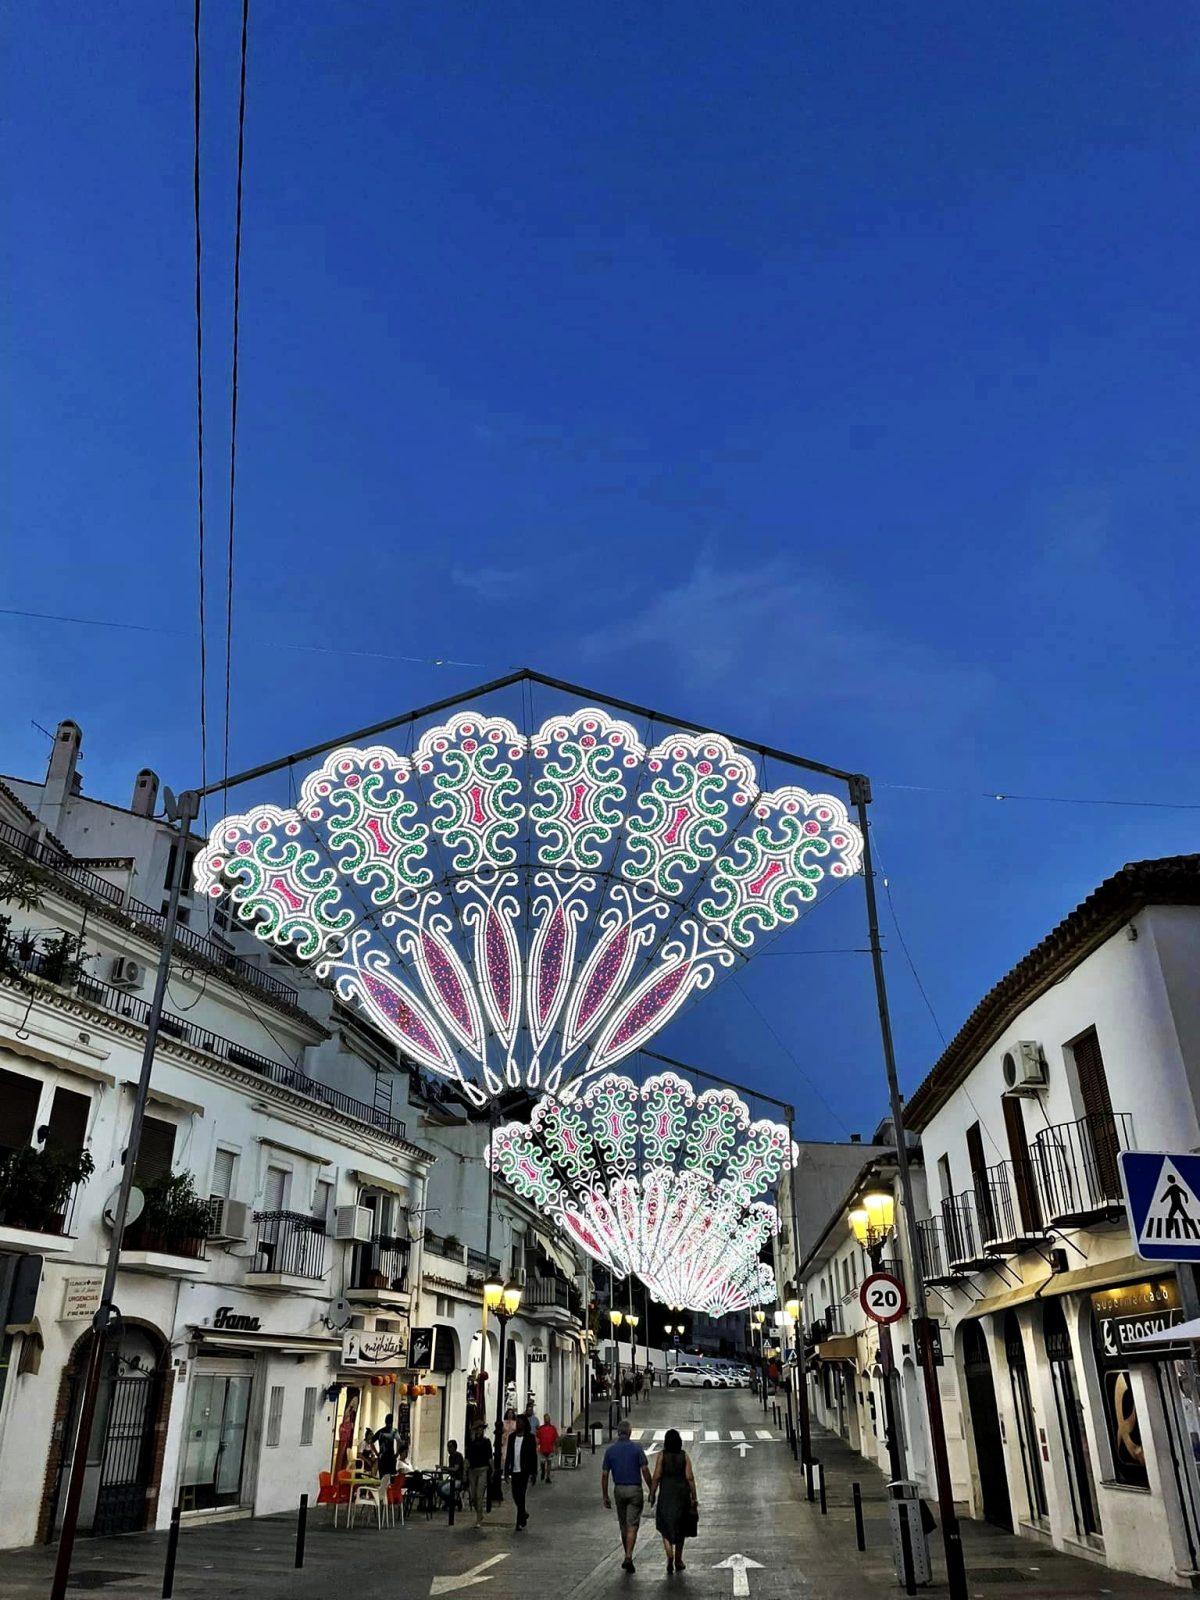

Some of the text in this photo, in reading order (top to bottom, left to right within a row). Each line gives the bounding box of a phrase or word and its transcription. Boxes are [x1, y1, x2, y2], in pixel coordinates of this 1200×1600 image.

[871, 1290, 898, 1307] 20
[213, 1306, 262, 1331] Fama
[1118, 1319, 1165, 1344] EROSKI
[527, 1353, 547, 1363] BAZAR
